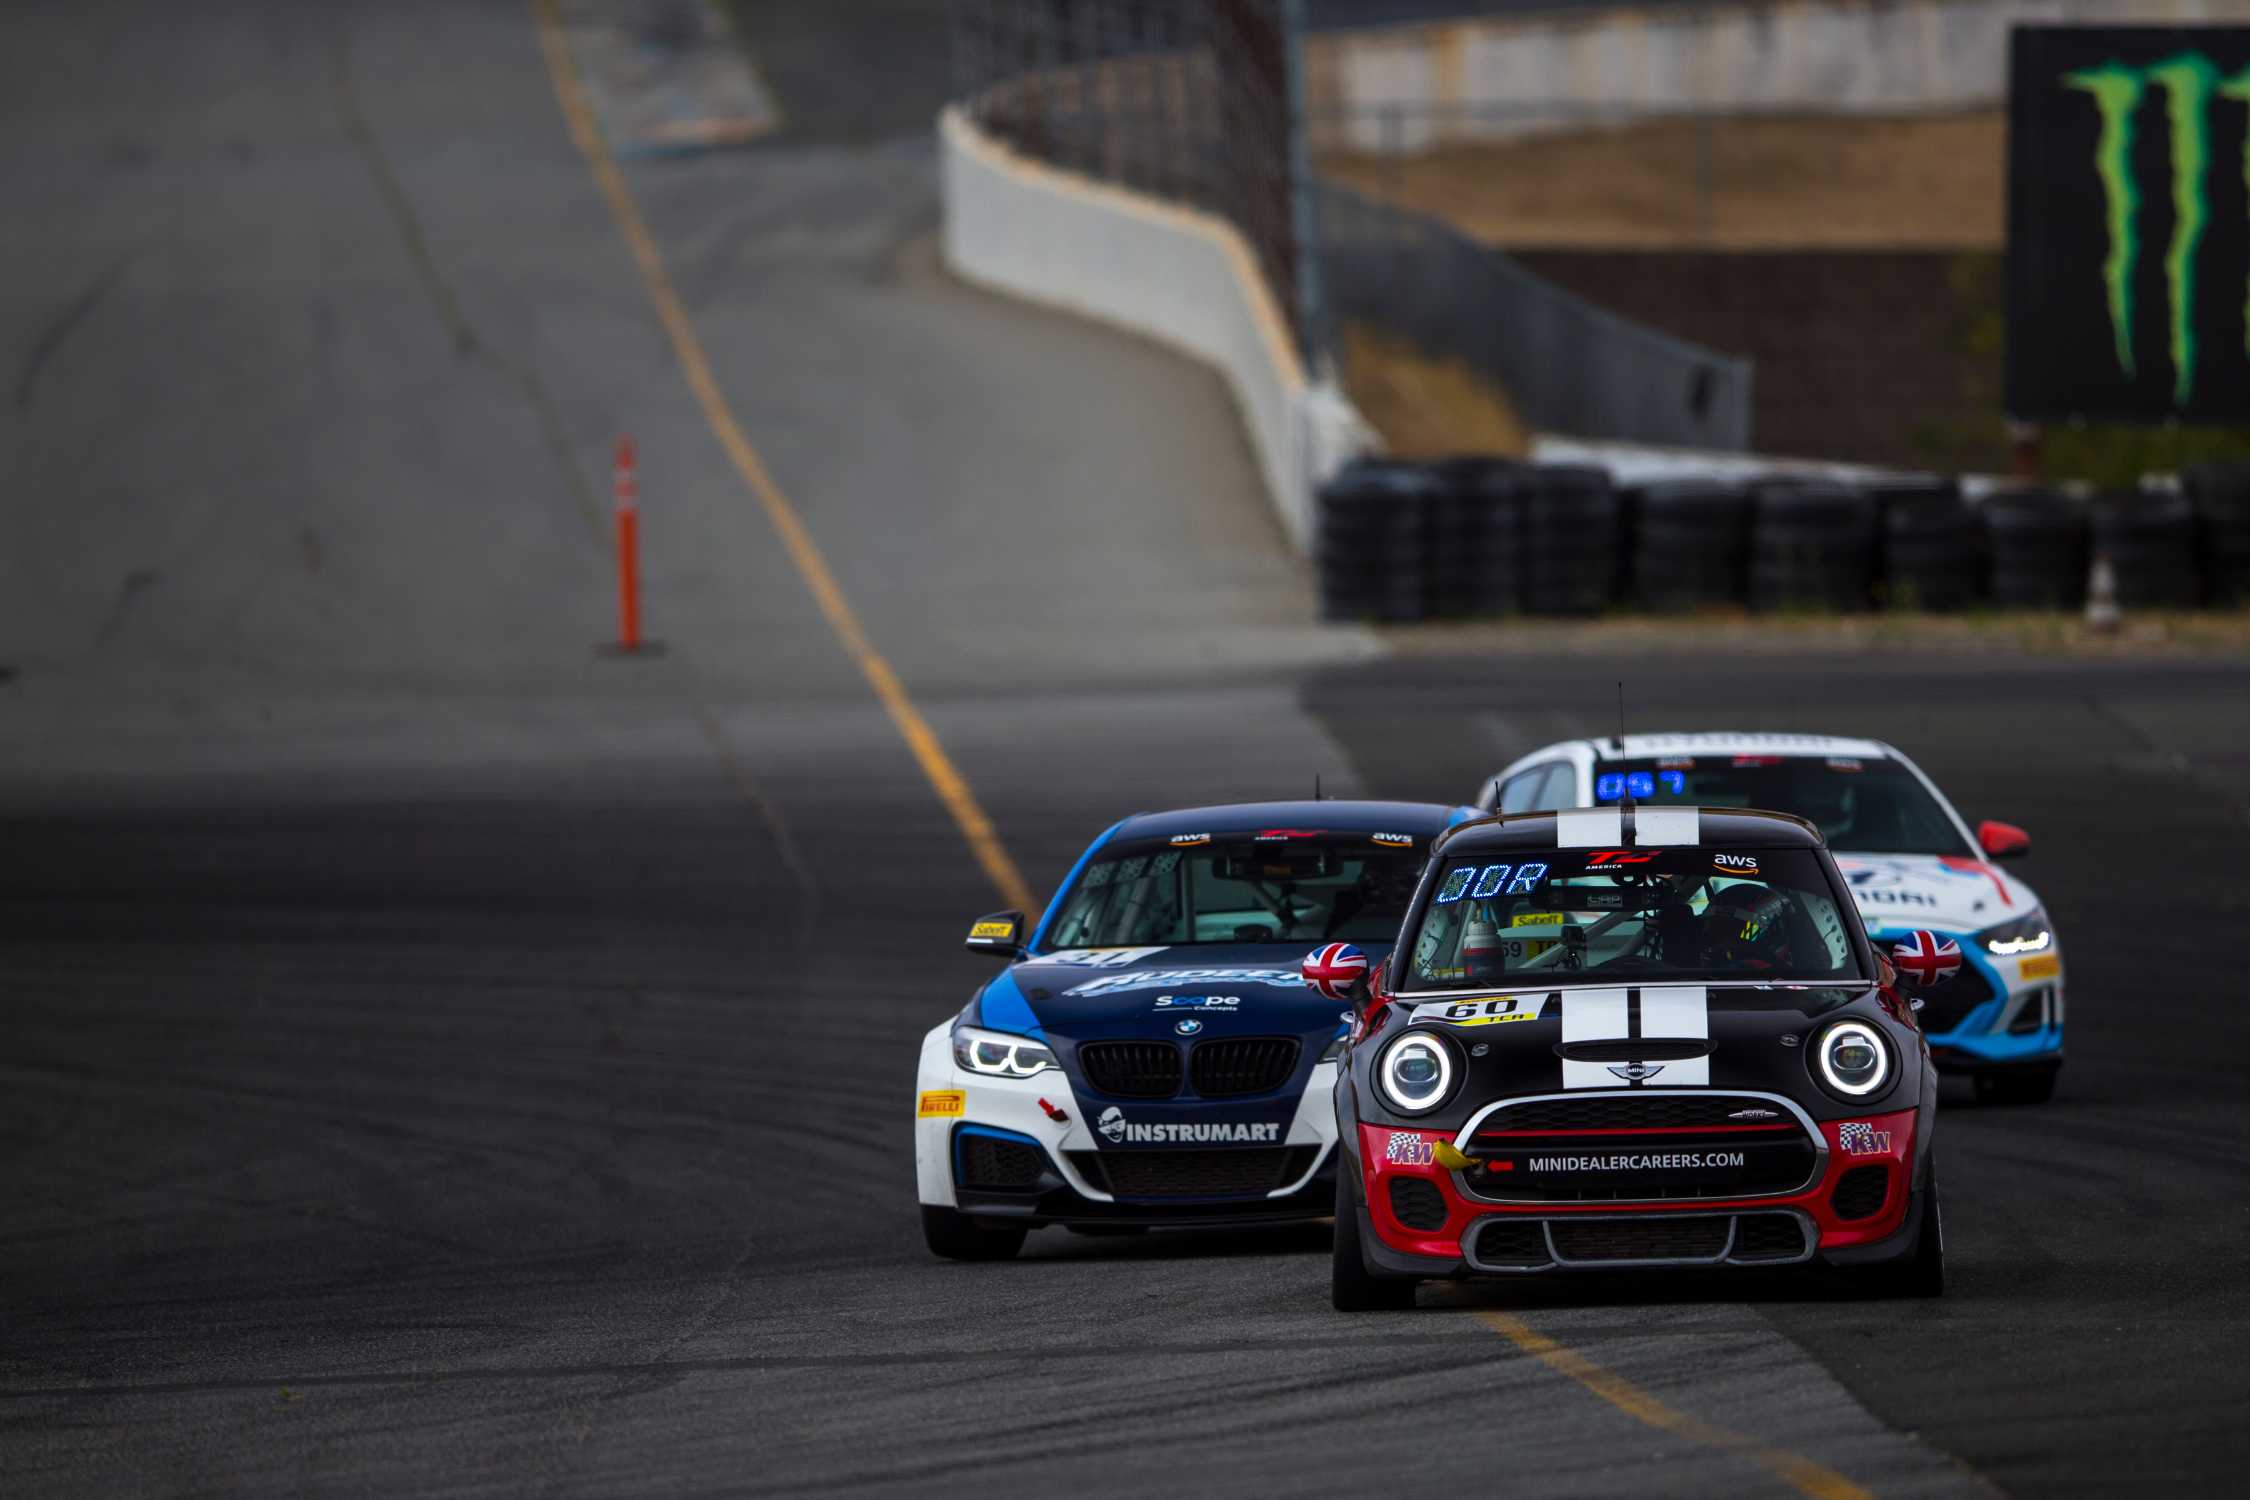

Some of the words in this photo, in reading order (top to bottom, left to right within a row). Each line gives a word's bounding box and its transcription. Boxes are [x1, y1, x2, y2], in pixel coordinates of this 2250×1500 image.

[1171, 833, 1211, 843] aws
[1372, 832, 1412, 844] aws
[1714, 853, 1757, 868] aws
[1446, 999, 1518, 1018] 60
[1626, 1066, 1646, 1074] MINI
[1126, 1123, 1280, 1142] INSTRUMART
[1529, 1152, 1745, 1172] MINIDEALERCAREERS.COM
